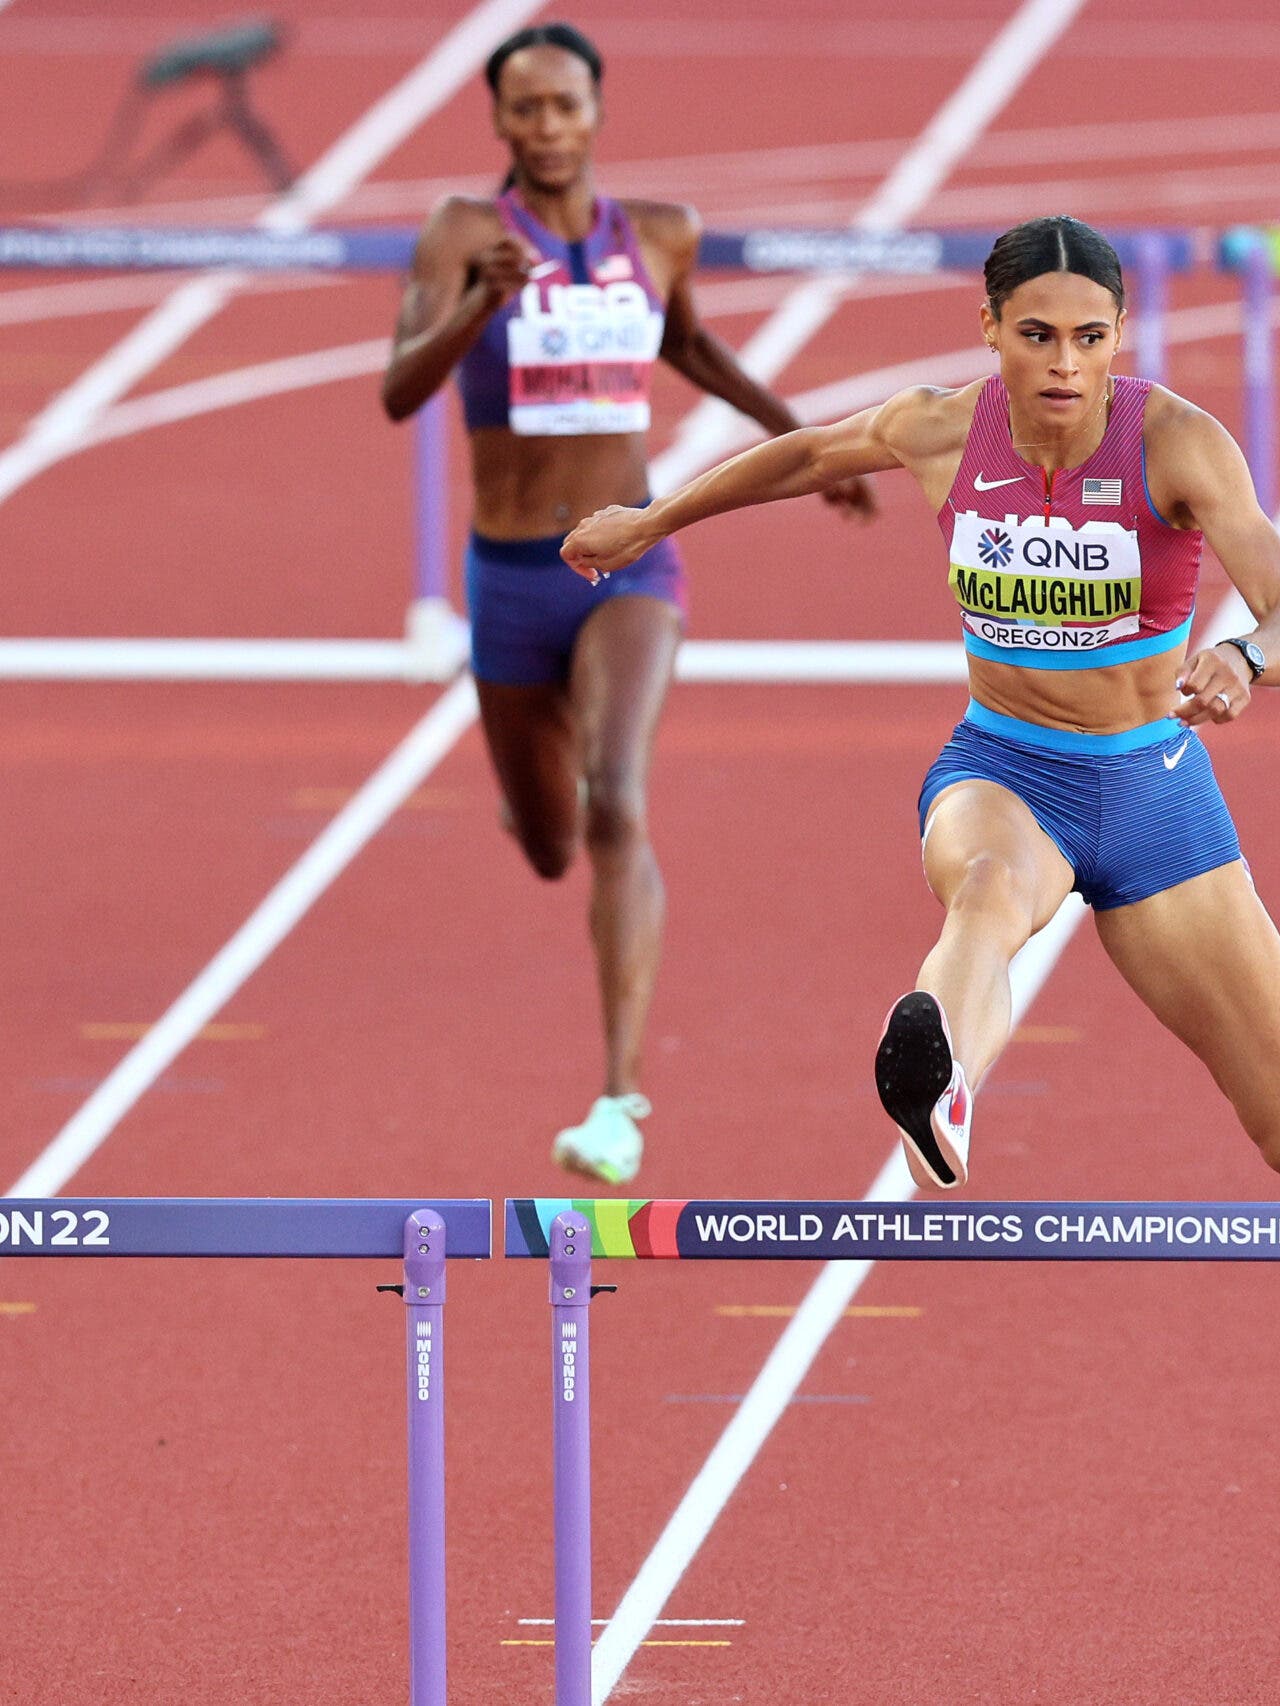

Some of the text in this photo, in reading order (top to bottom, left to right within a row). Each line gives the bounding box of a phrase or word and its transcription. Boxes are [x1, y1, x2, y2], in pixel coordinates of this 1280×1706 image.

[1022, 536, 1110, 572] QNB
[956, 568, 1133, 617] McLAUGHLIN
[980, 622, 1110, 648] OREGON22
[0, 1210, 111, 1246] N22
[695, 1213, 824, 1242] WORLD
[832, 1213, 1024, 1243] ATHLETICS
[416, 1339, 432, 1401] MONDO
[561, 1340, 577, 1402] MONDO
